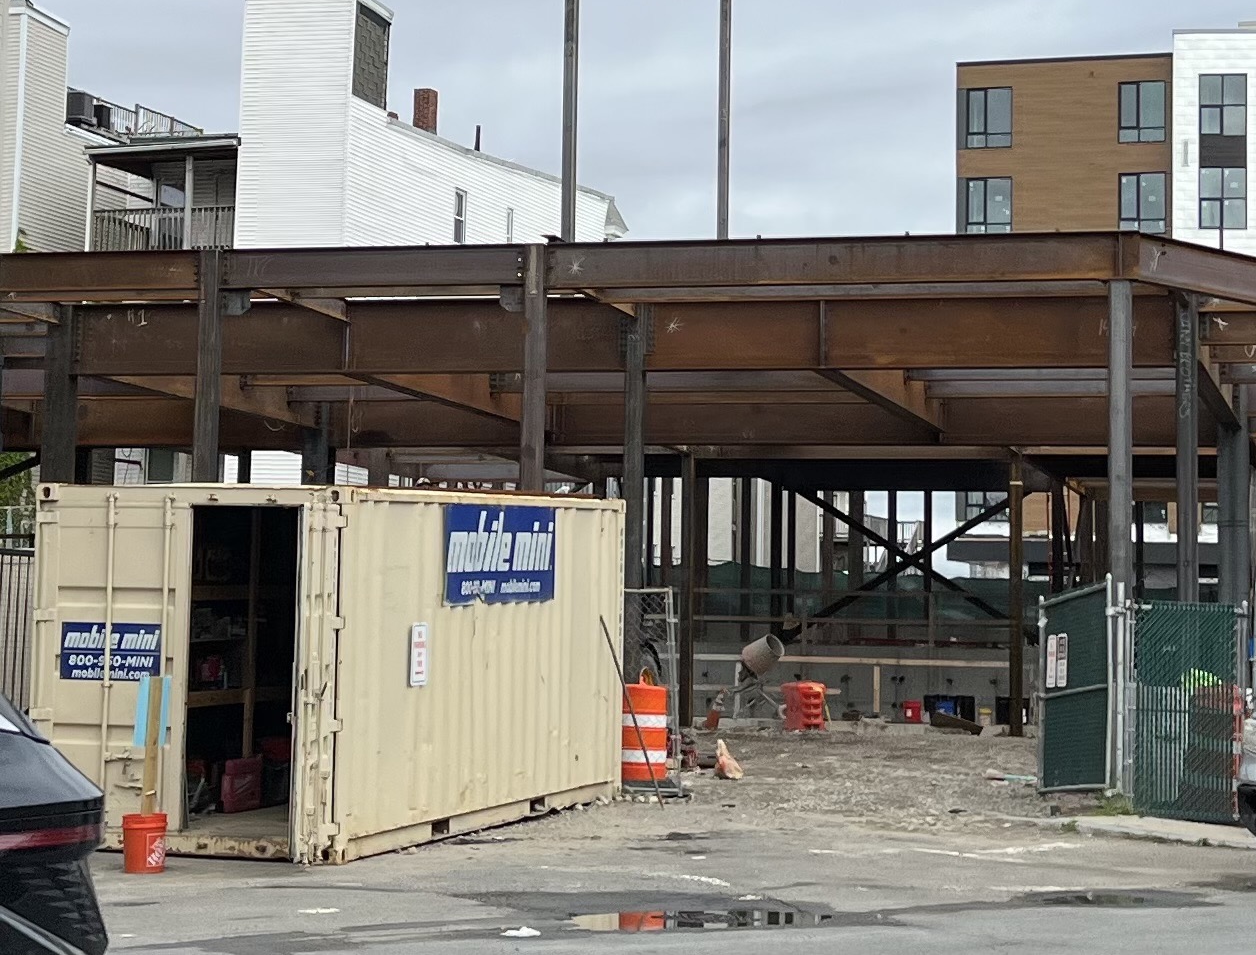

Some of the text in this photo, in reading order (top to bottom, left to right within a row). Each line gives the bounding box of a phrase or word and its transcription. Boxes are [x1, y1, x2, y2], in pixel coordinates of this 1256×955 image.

[447, 510, 554, 573] mobile mini
[120, 629, 160, 650] mini
